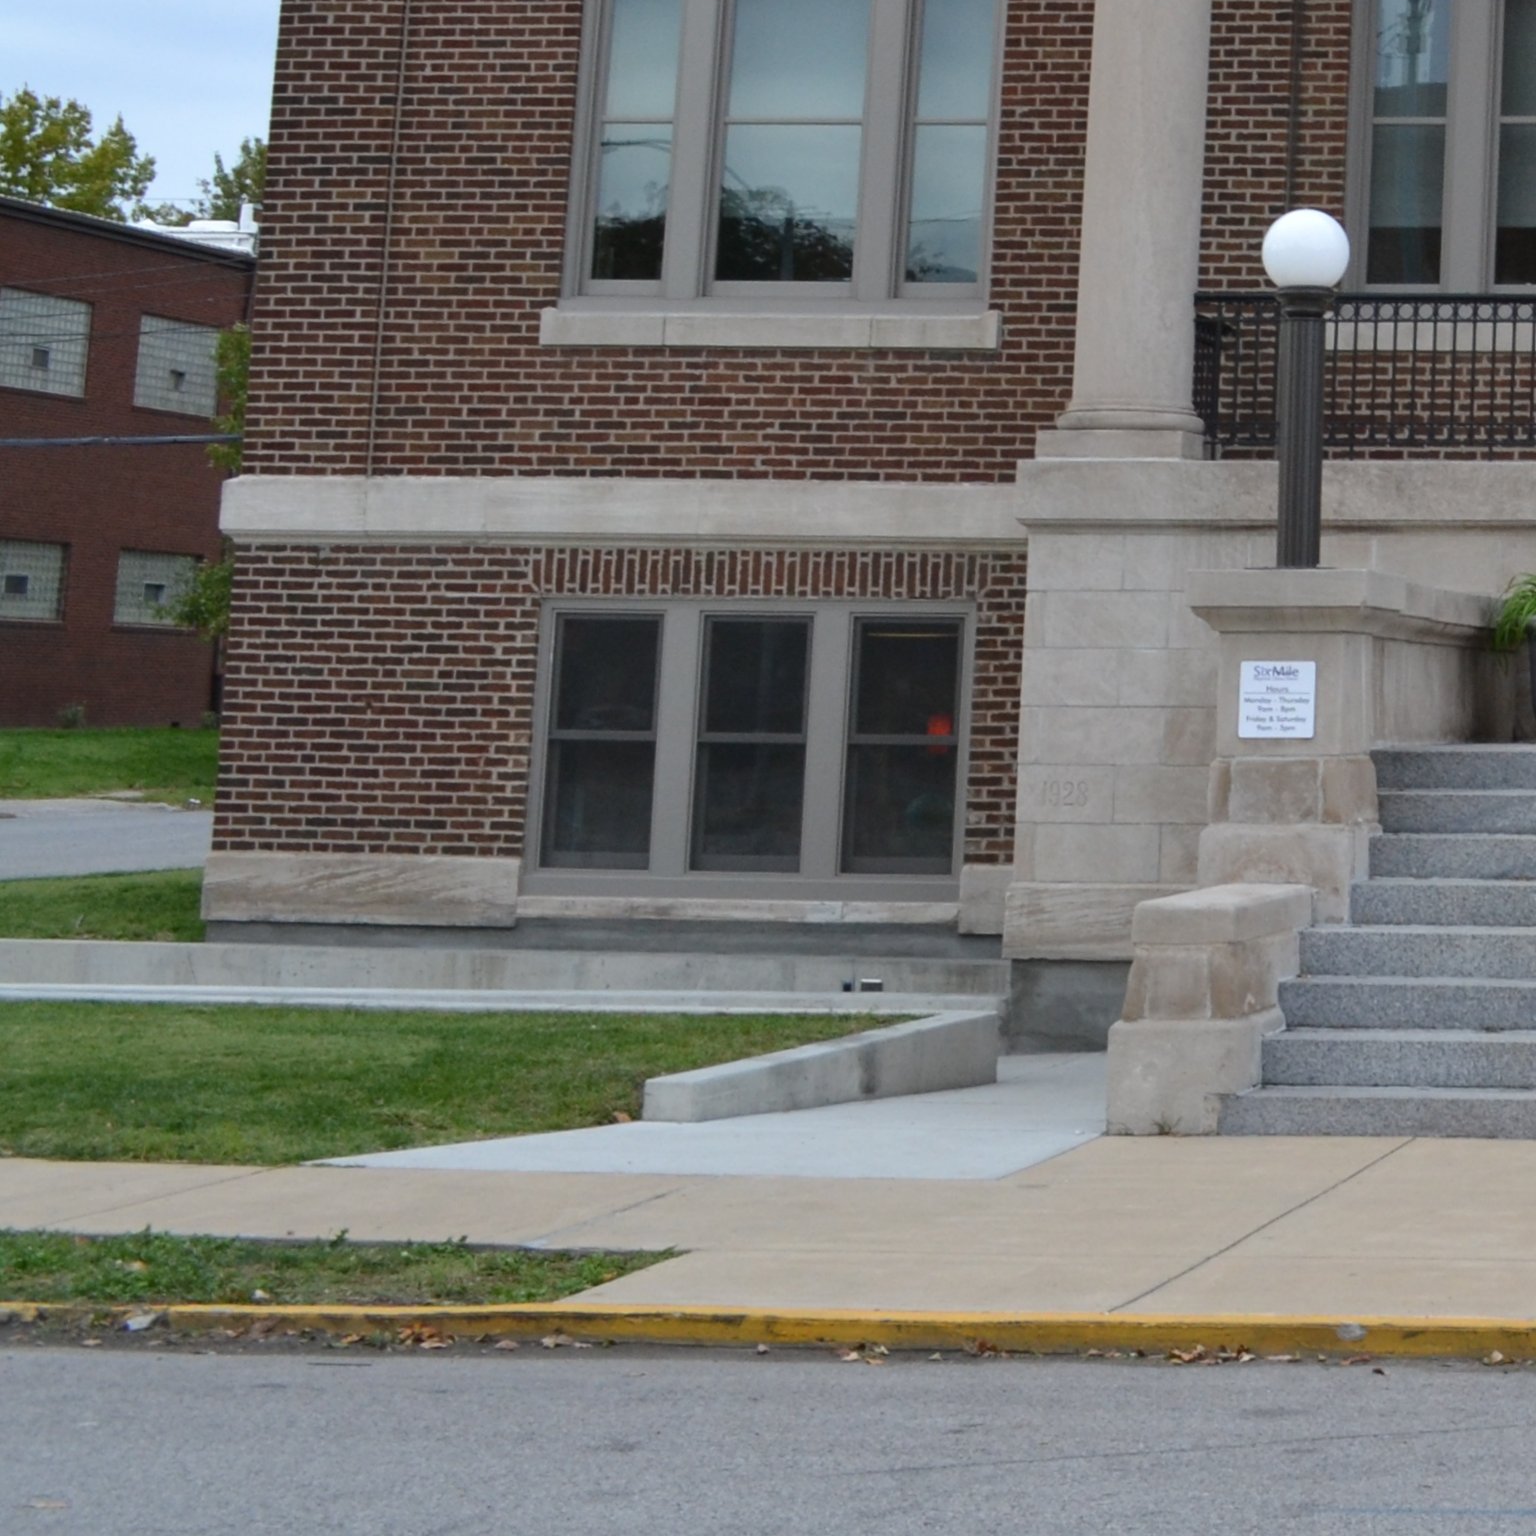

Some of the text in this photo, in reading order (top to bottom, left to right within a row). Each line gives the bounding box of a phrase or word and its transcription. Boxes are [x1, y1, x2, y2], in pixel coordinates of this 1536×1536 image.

[1266, 685, 1289, 693] Hours
[1279, 697, 1310, 705] Thursday
[1276, 716, 1306, 724] Saturday
